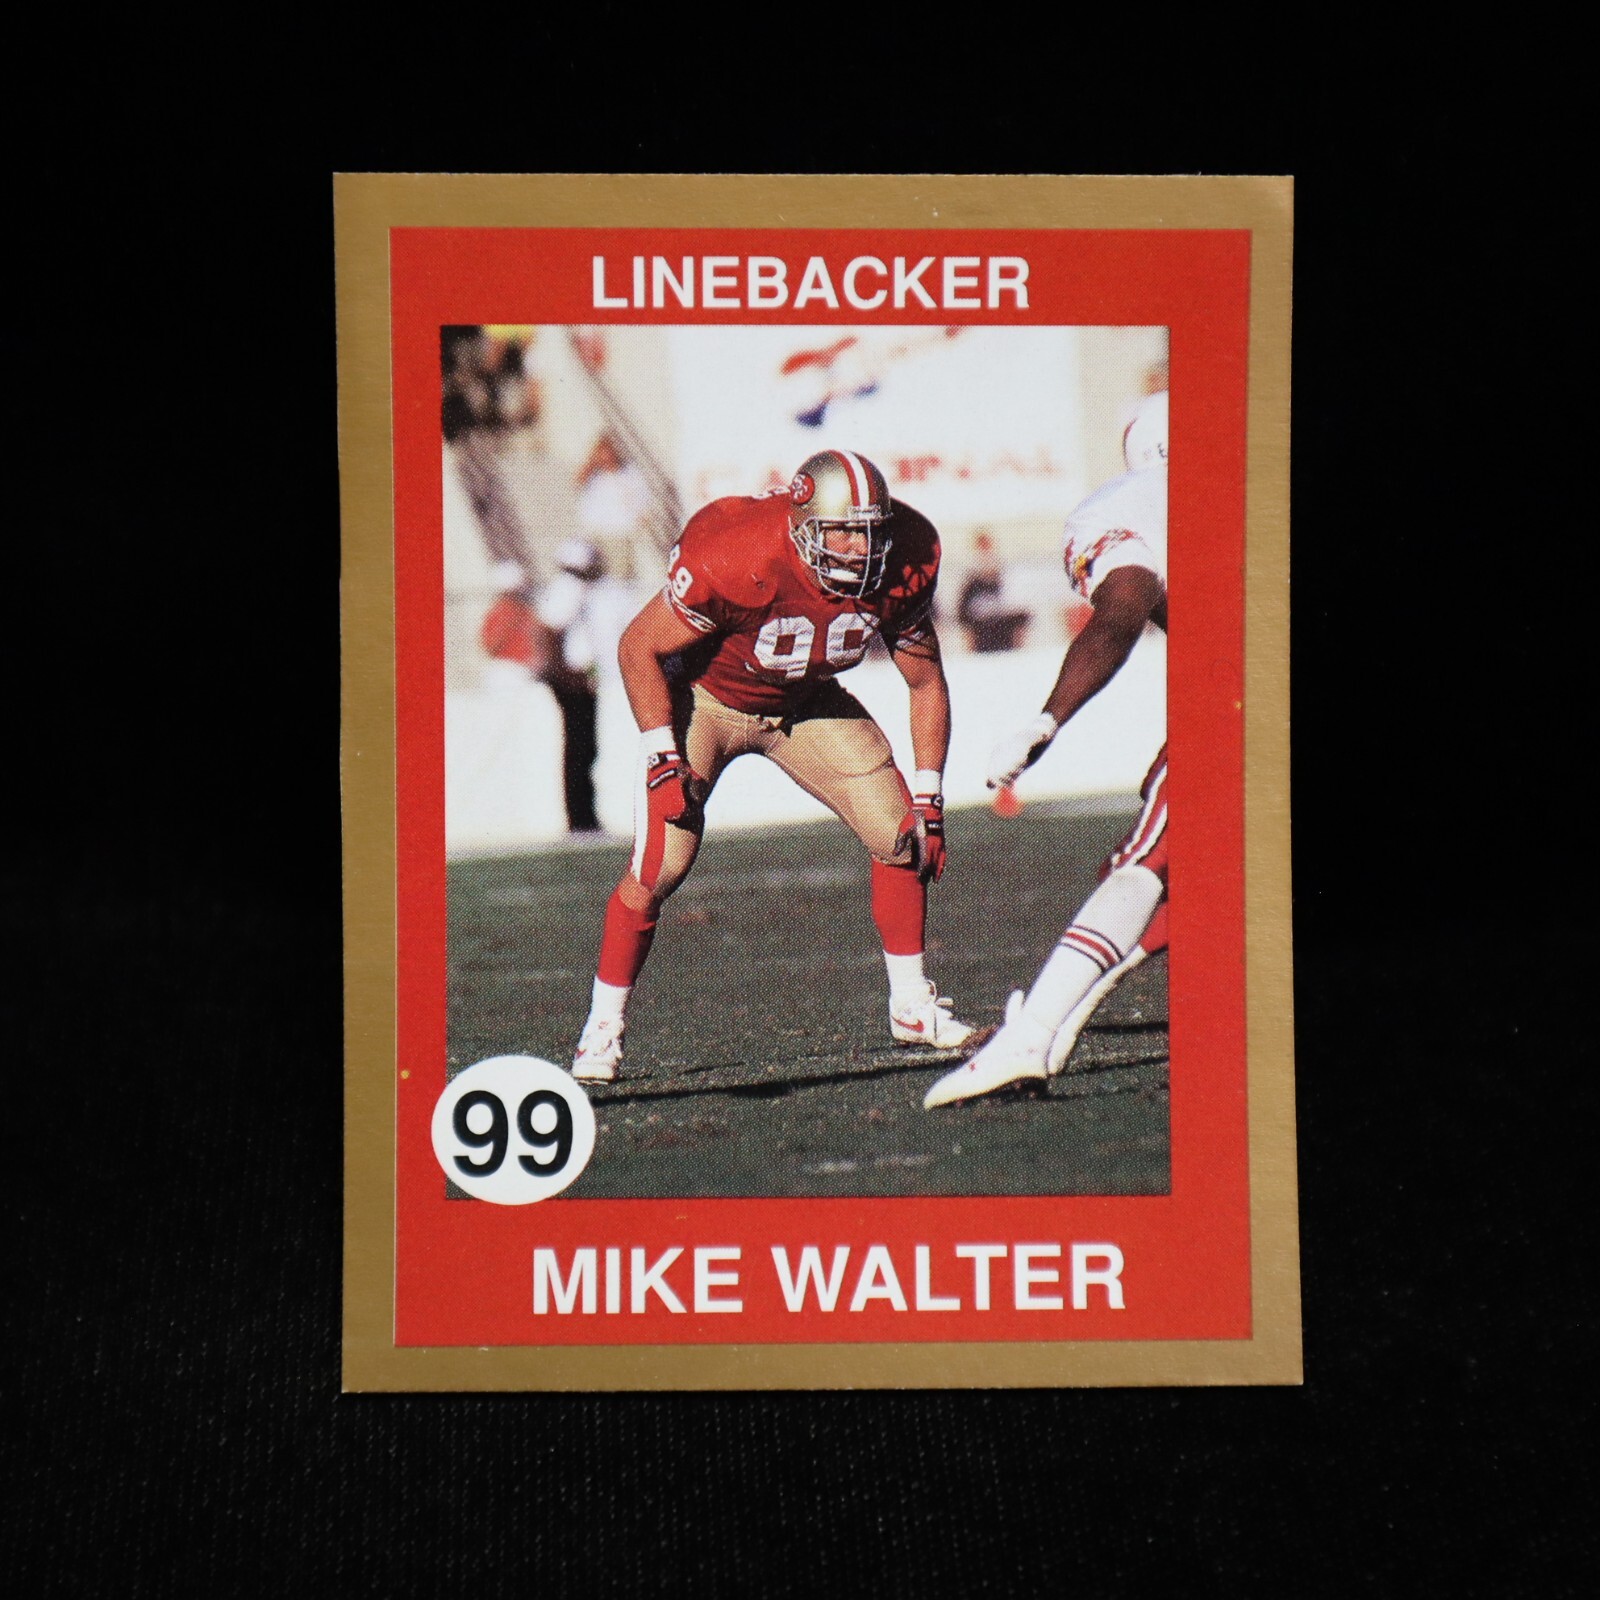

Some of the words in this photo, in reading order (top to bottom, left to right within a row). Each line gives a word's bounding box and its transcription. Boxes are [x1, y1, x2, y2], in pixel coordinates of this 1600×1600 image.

[591, 255, 1031, 311] LINEBACKER
[453, 1089, 573, 1178] 99
[532, 1246, 743, 1316] MIKE
[771, 1242, 1126, 1314] WALTER
